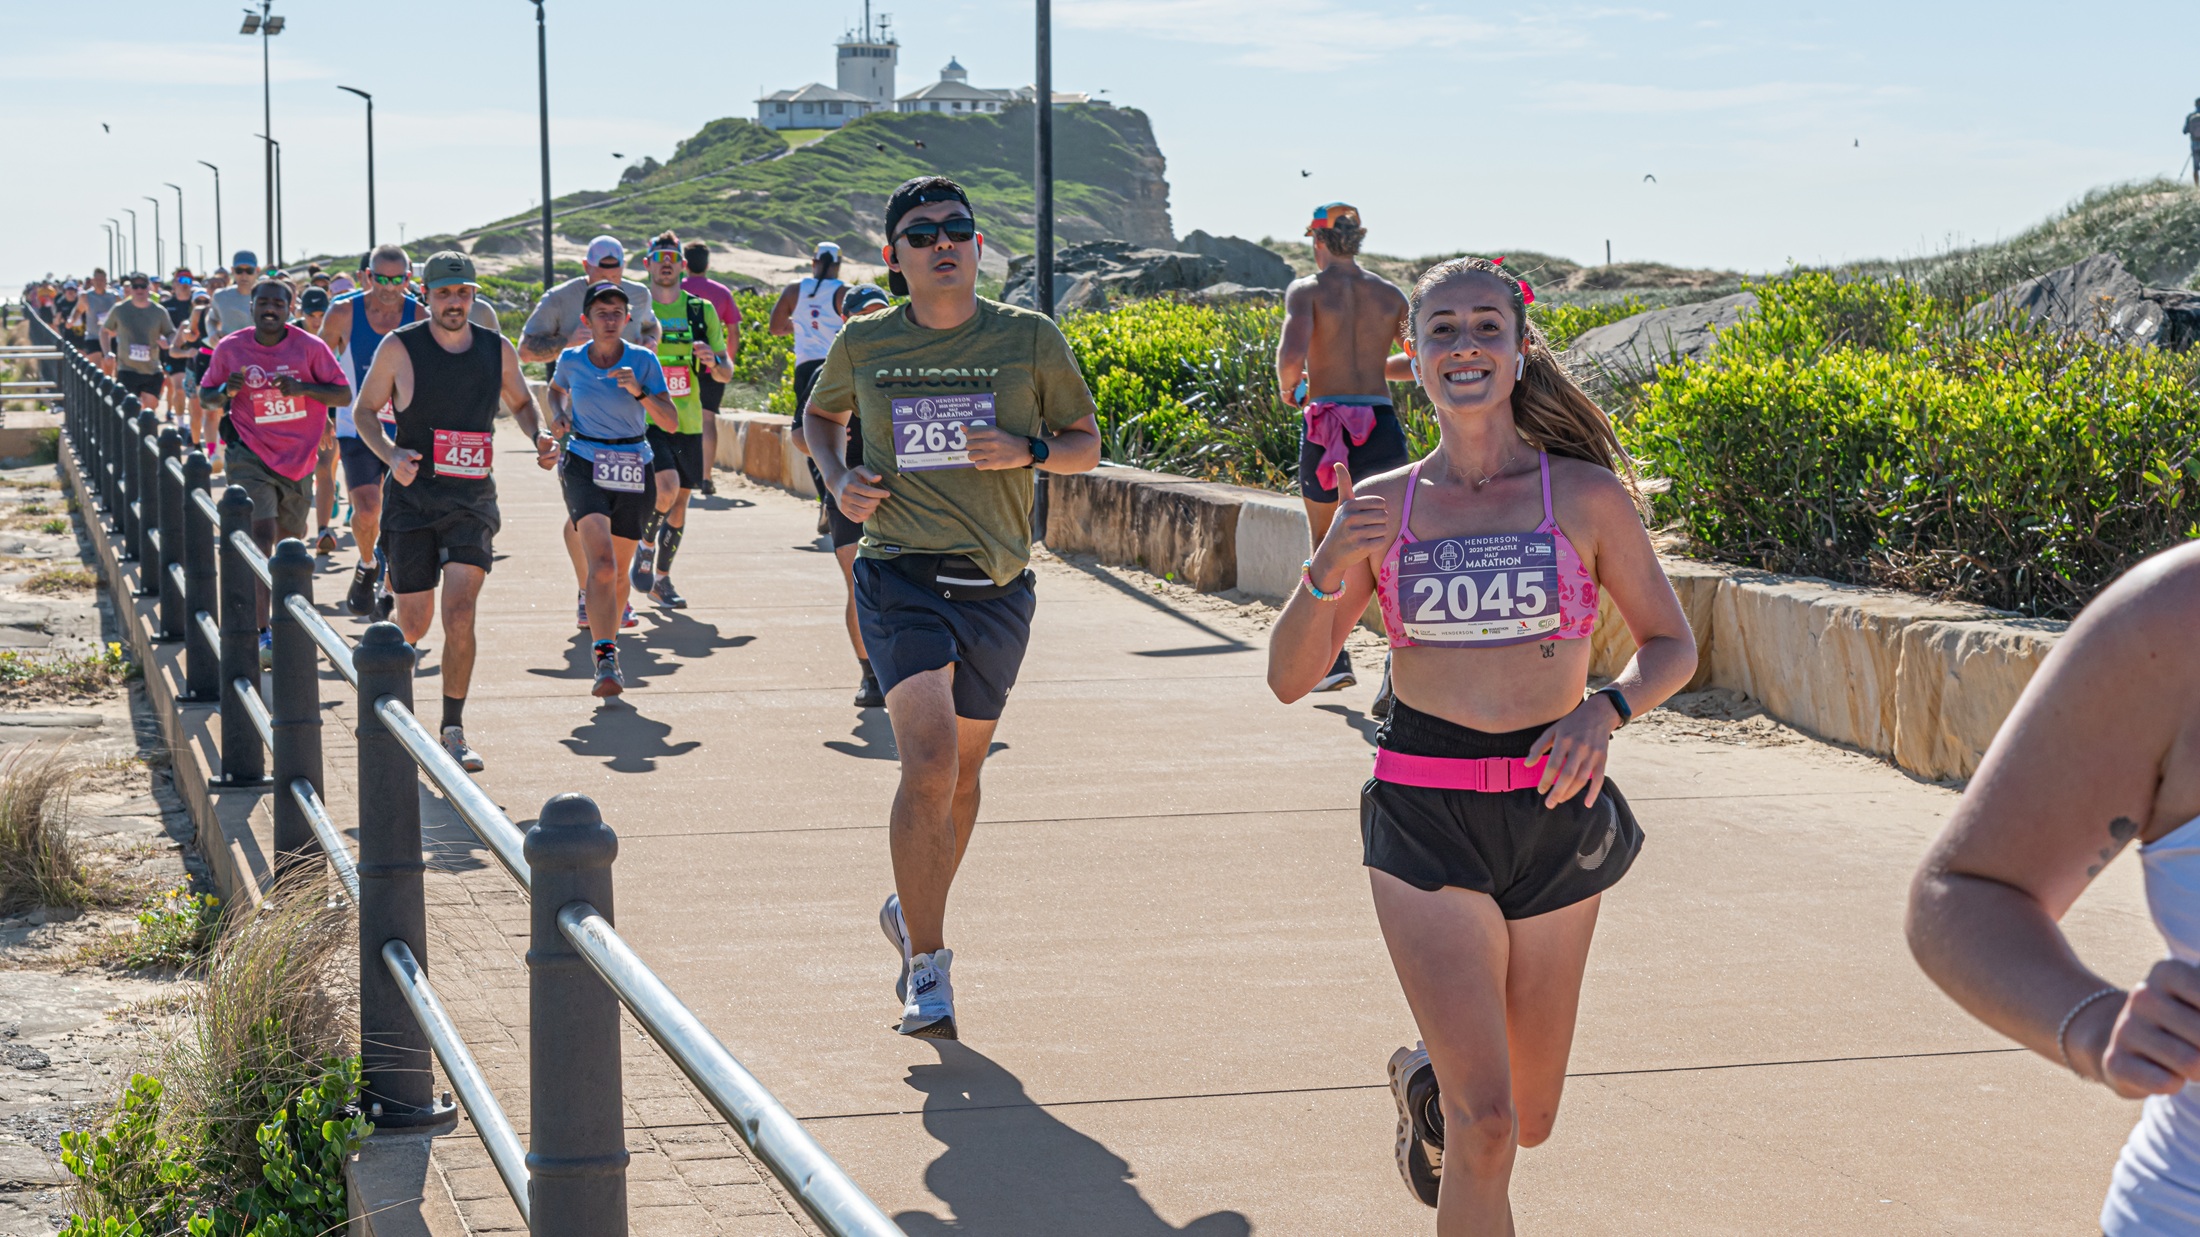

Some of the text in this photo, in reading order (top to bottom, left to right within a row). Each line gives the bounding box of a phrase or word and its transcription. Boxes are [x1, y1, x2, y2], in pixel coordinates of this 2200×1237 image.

[875, 368, 999, 388] SAUCONY
[264, 398, 295, 416] 361
[903, 419, 988, 453] 263
[445, 446, 485, 467] 454
[598, 463, 642, 483] 3166
[1484, 544, 1517, 552] NEWCASTLE
[1465, 556, 1522, 569] MARATHON
[1413, 571, 1547, 622] 2045
